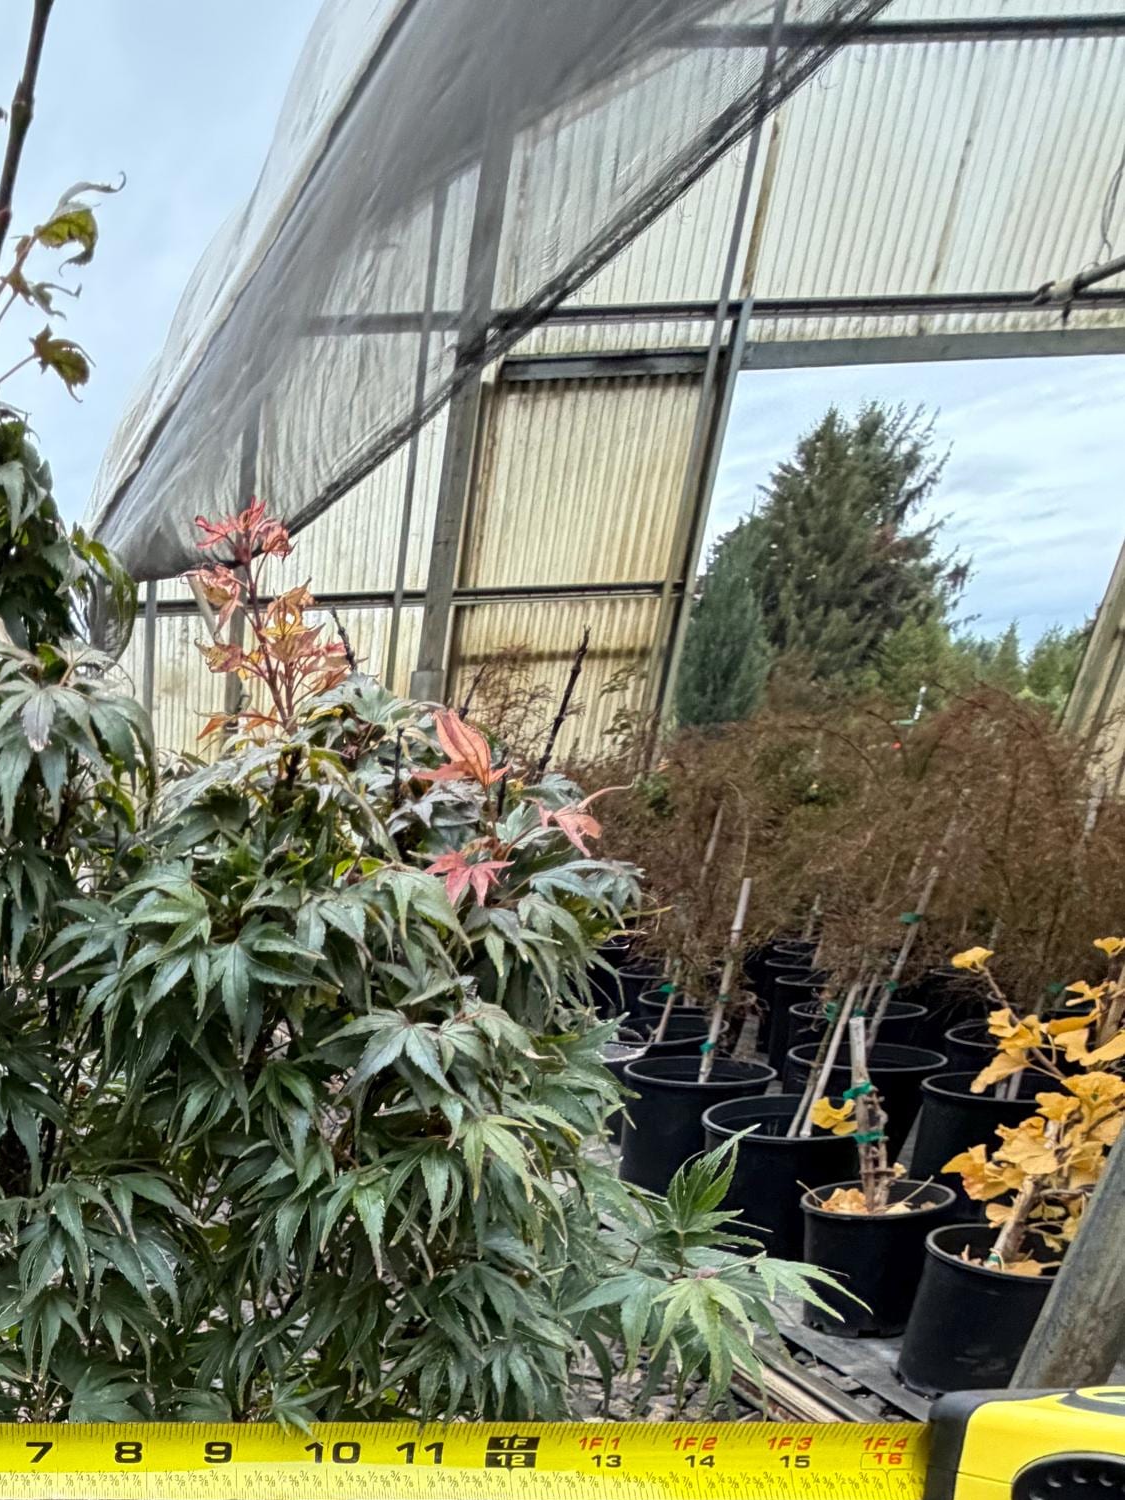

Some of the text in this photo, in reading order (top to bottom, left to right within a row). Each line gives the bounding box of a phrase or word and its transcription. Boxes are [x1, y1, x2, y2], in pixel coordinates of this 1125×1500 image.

[499, 1438, 528, 1449] 1F
[25, 1441, 53, 1463] 7
[114, 1441, 143, 1464] 8
[204, 1441, 233, 1464] 9
[304, 1441, 361, 1464] 10
[396, 1441, 445, 1465] 11
[496, 1453, 902, 1468] 12 13 14 15 16
